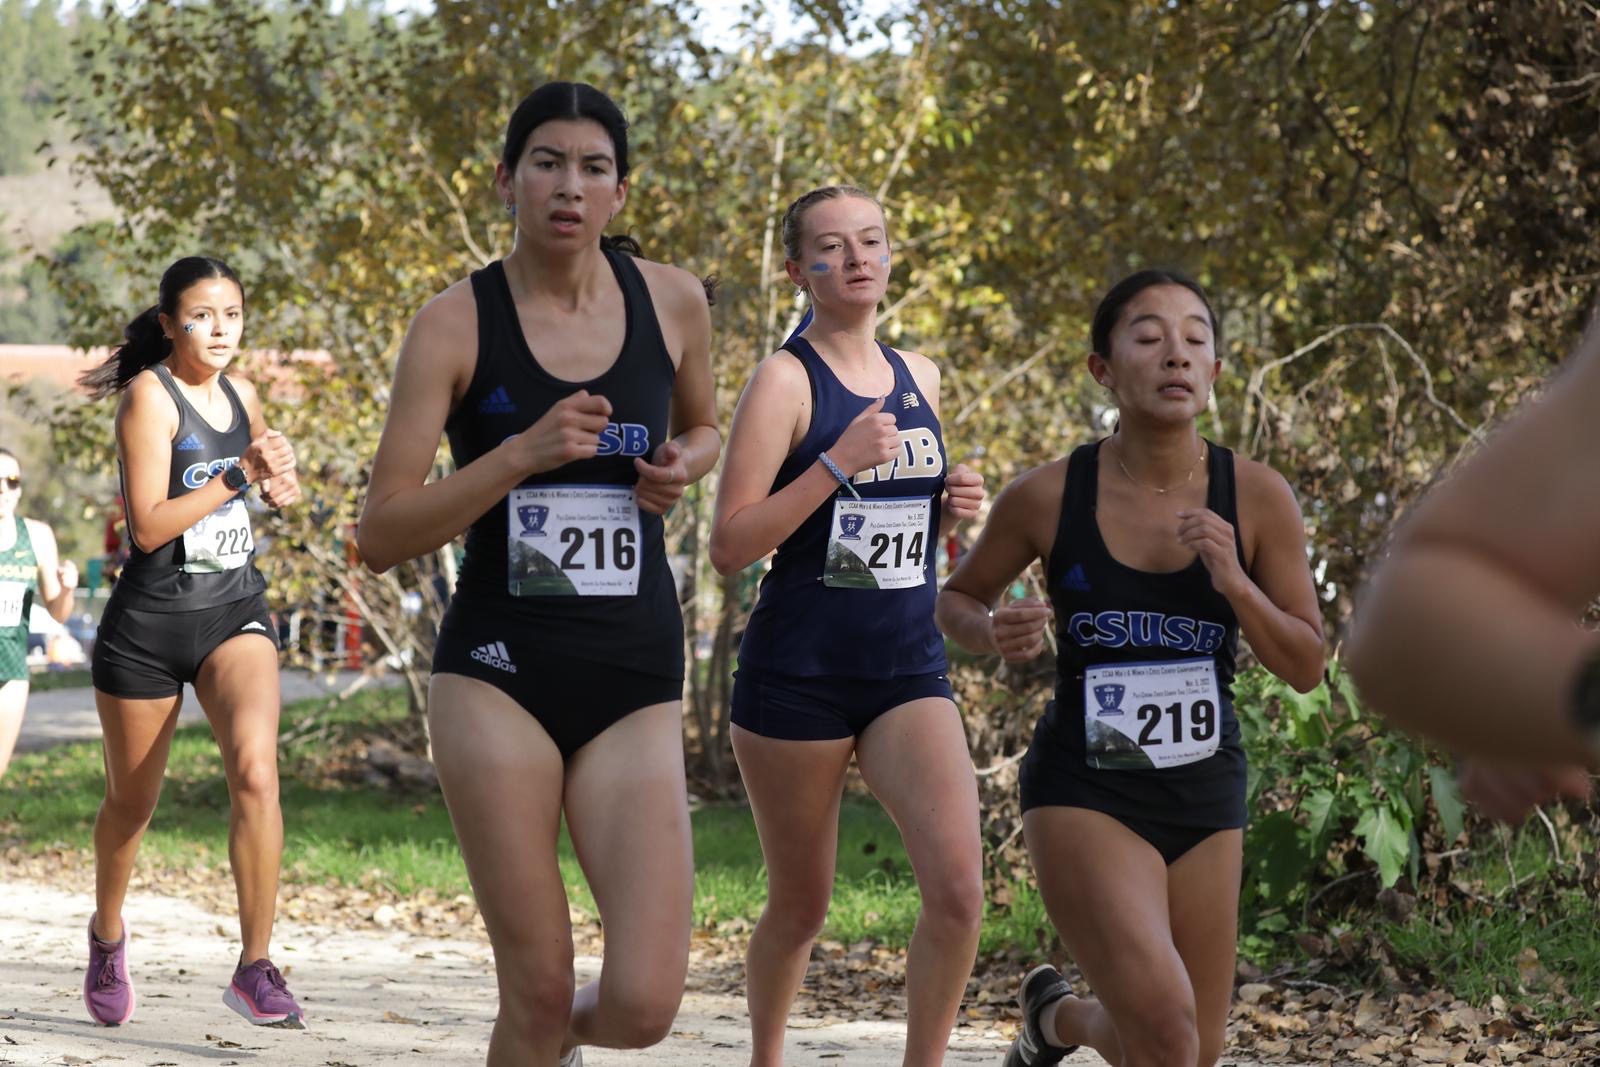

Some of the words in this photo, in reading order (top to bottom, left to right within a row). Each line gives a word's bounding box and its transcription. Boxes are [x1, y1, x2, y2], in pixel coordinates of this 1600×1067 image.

[215, 526, 251, 557] 222
[560, 526, 636, 571] 216
[868, 531, 924, 568] 214
[1068, 610, 1225, 654] CSUSB
[470, 650, 517, 674] adidas
[1137, 699, 1215, 746] 219
